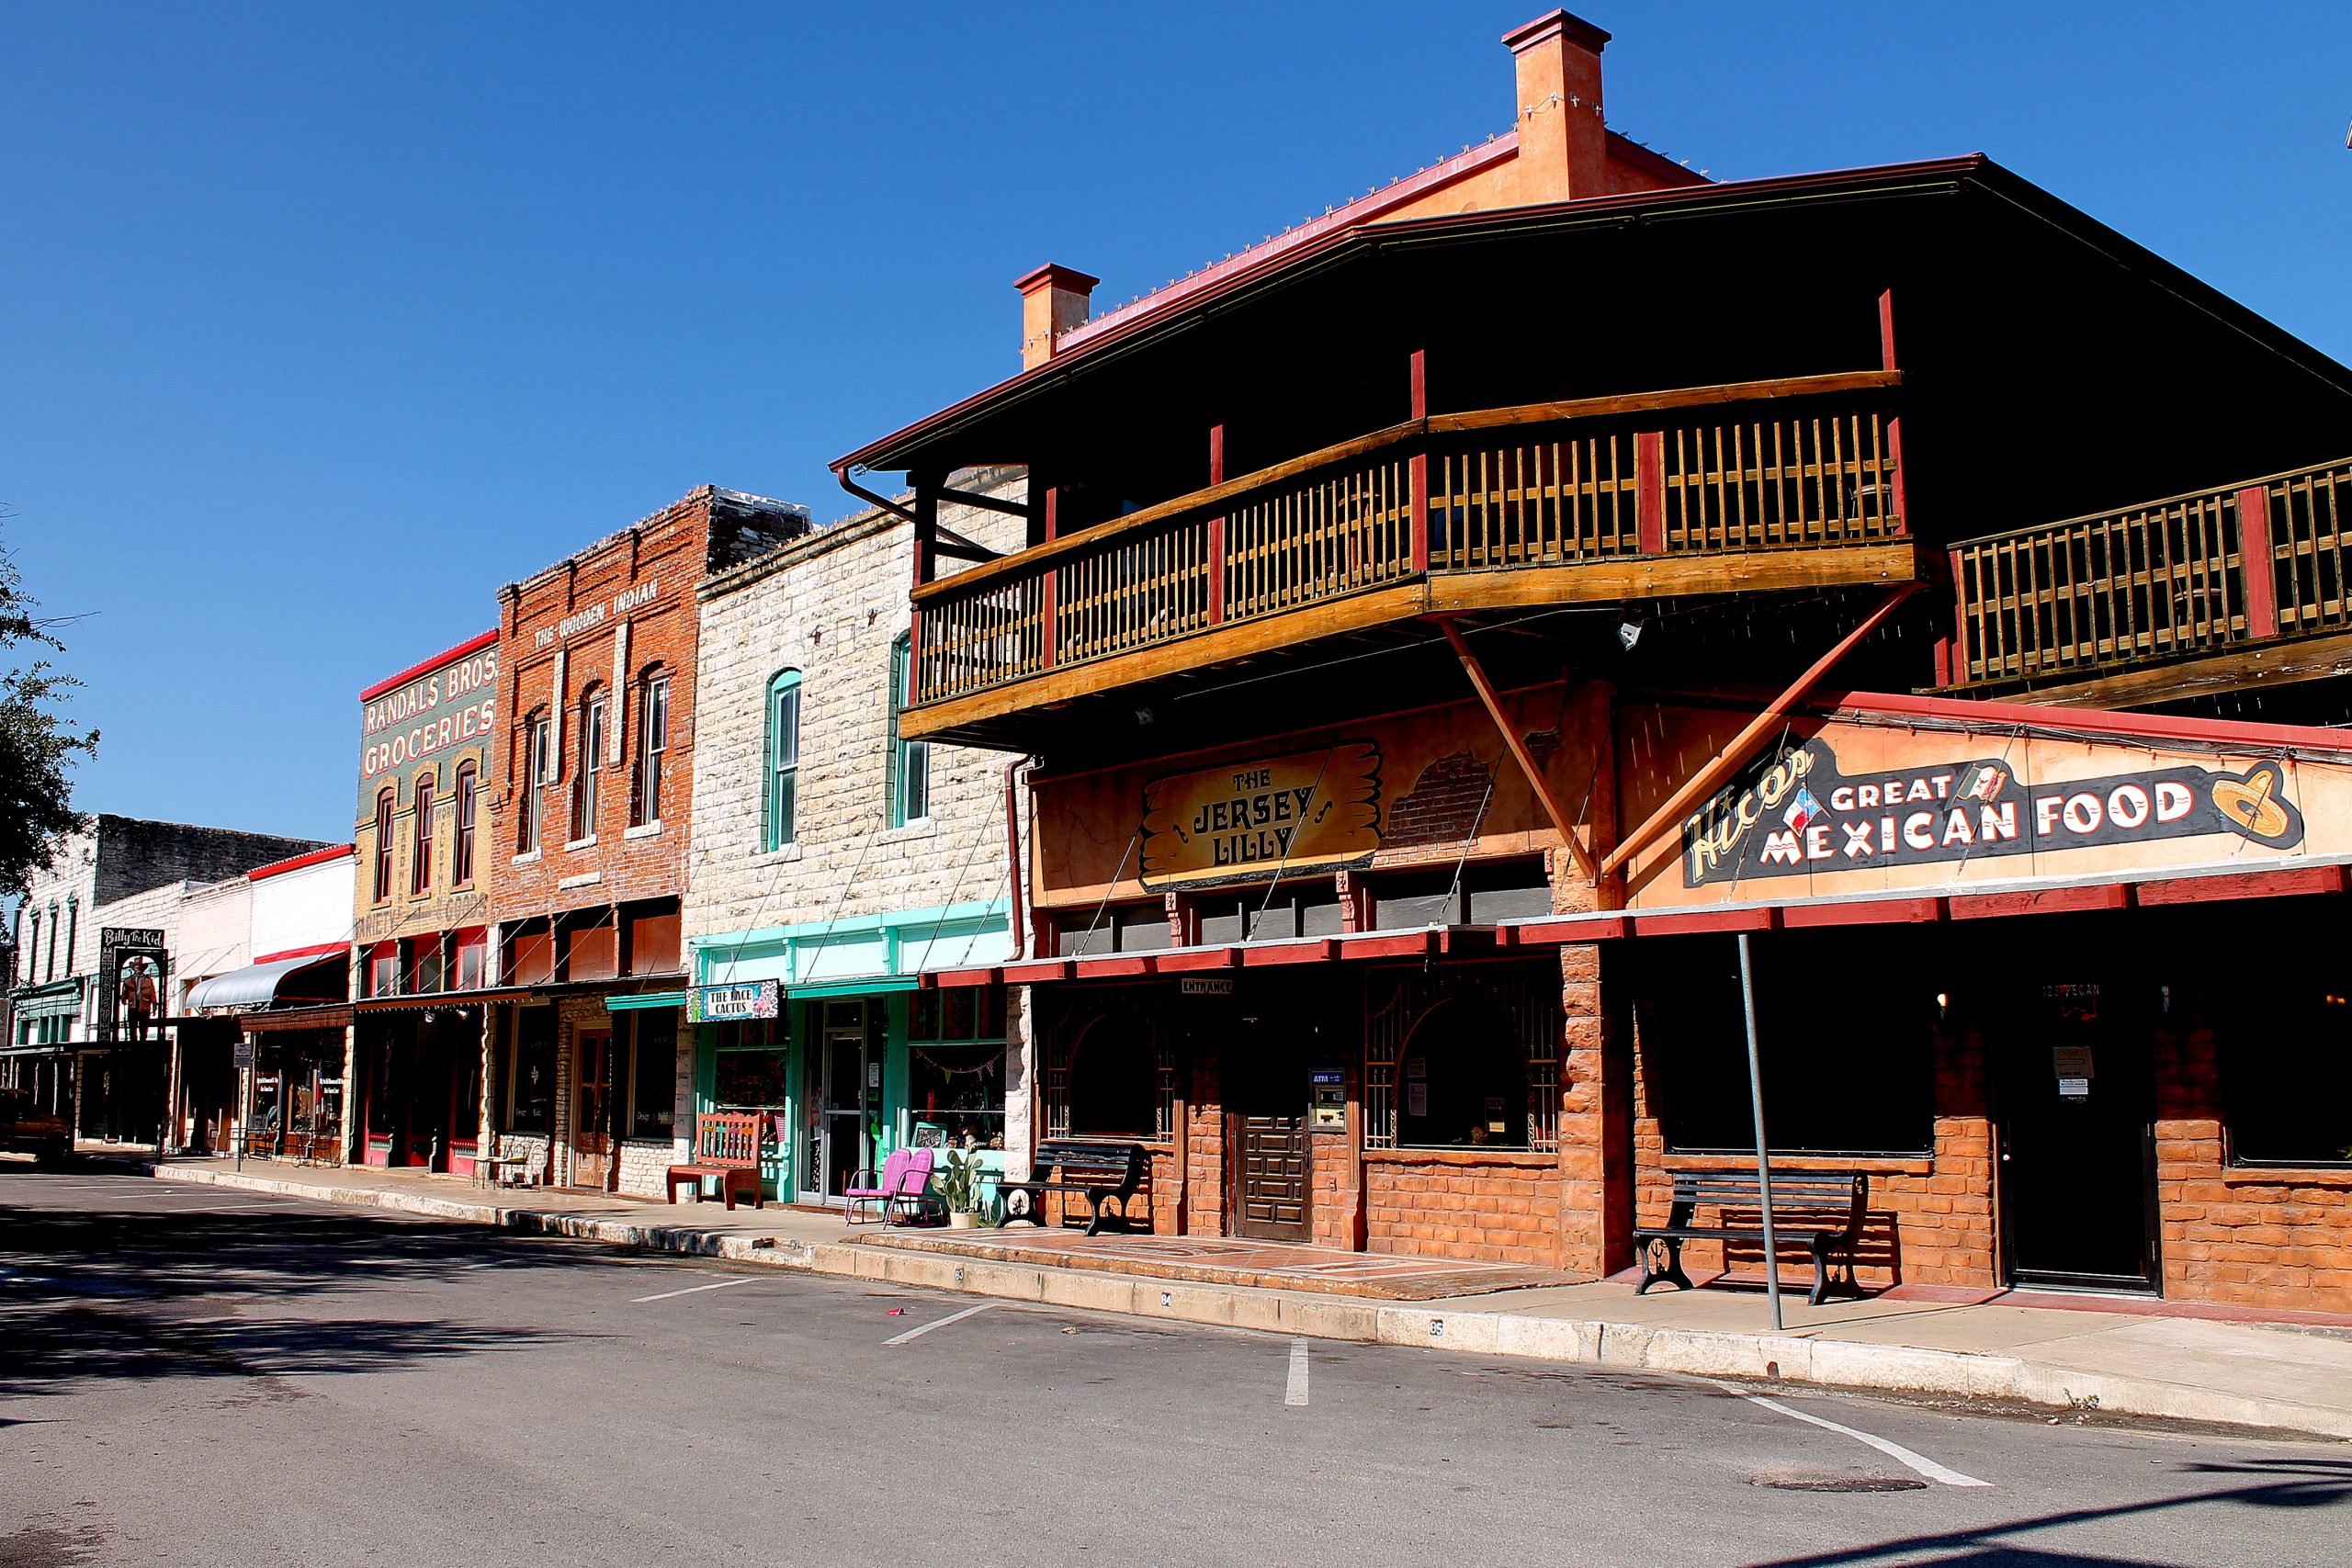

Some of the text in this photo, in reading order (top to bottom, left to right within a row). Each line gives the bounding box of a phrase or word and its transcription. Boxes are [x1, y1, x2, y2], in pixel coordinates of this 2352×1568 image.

[535, 578, 660, 649] THE WOODEN INDIAN
[366, 649, 499, 737] RANDALS BROS.
[364, 698, 496, 781] GROCERIES
[1232, 768, 1272, 793] THE
[1830, 773, 1954, 813] GREAT
[435, 804, 456, 822] WORK
[1193, 785, 1317, 835] JERSEY
[1759, 780, 2194, 866] MEXICAN FOOD
[1213, 826, 1294, 866] LILLY
[104, 929, 130, 946] Billy
[142, 931, 163, 947] Kid
[1182, 980, 1232, 993] ENTRANCE
[2064, 984, 2100, 998] PECAN
[711, 991, 728, 1003] THE
[716, 1002, 746, 1014] CACTUS
[1313, 1075, 1329, 1083] ATM
[956, 1269, 964, 1280] 83
[1161, 1293, 1171, 1306] 84
[1430, 1321, 1443, 1336] 85
